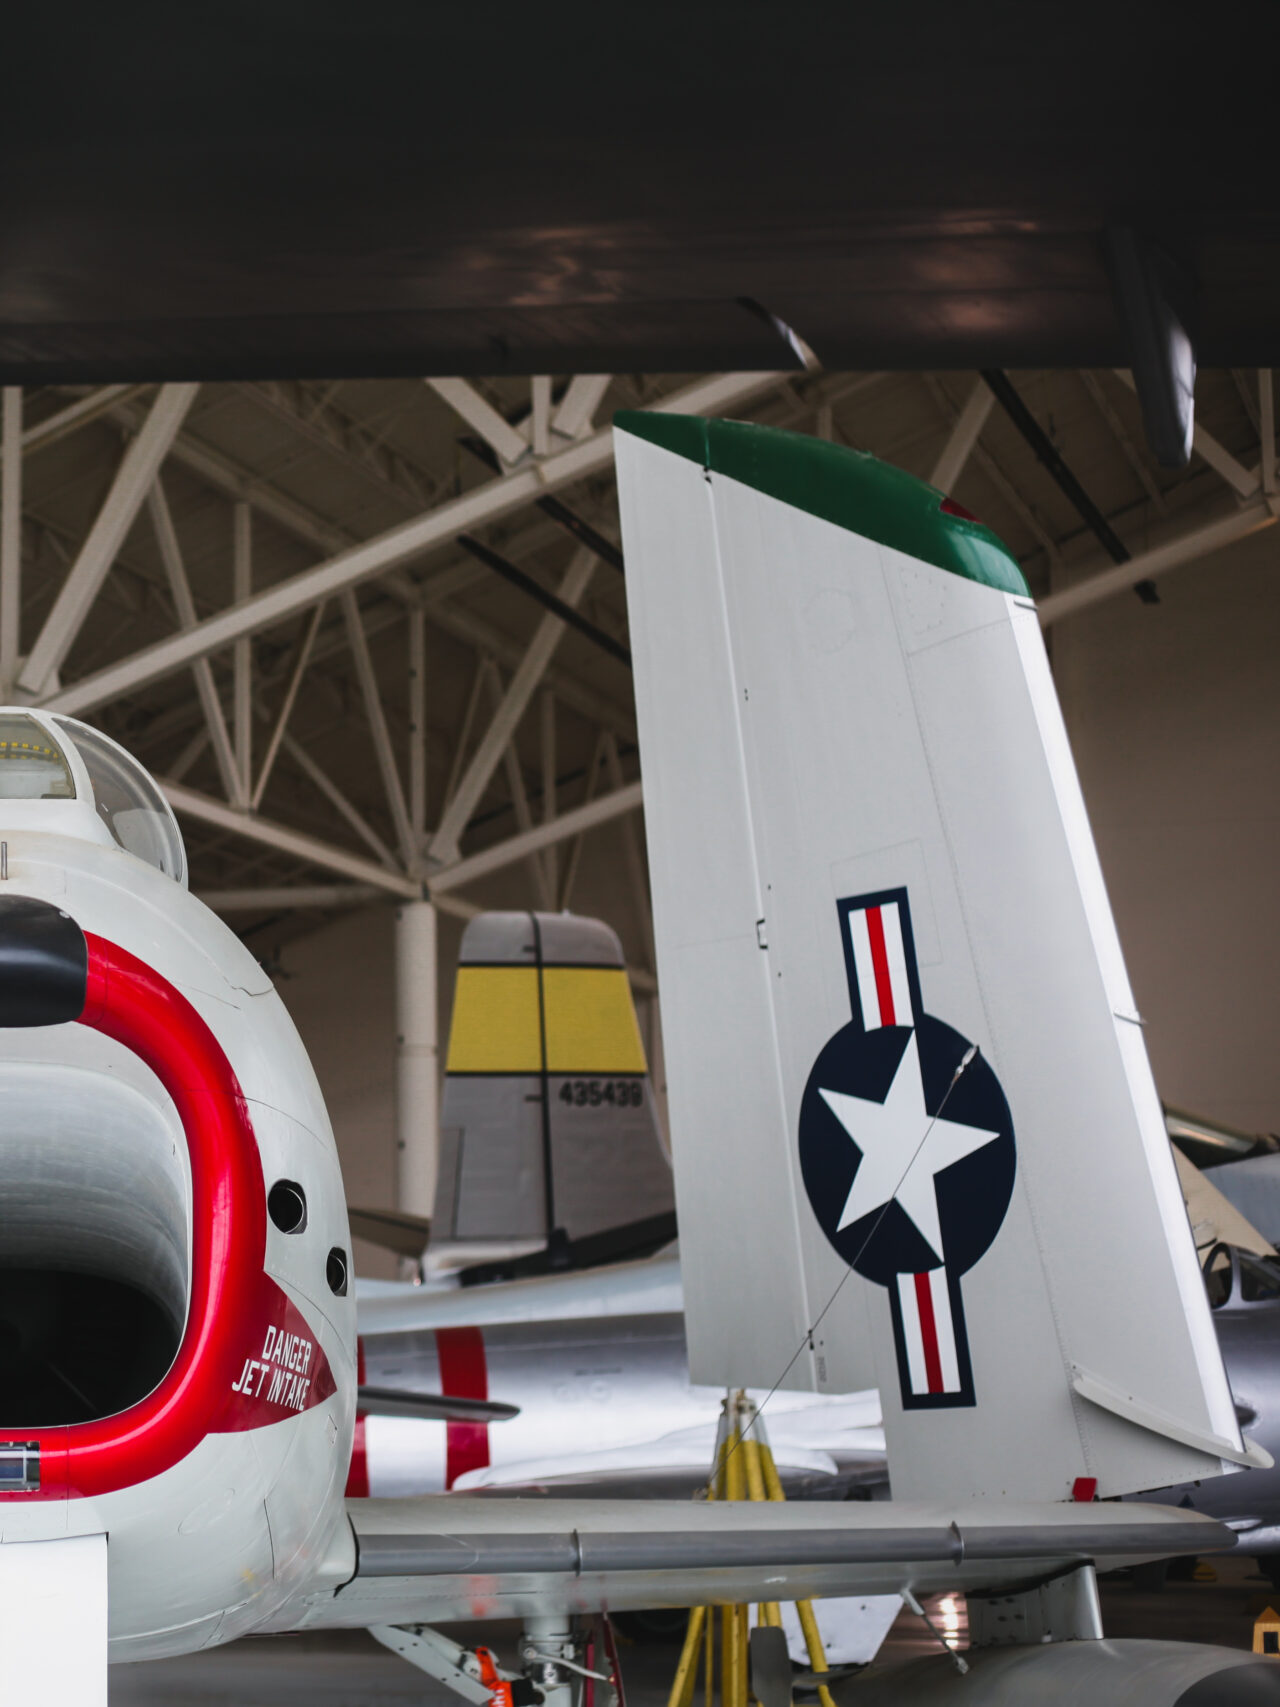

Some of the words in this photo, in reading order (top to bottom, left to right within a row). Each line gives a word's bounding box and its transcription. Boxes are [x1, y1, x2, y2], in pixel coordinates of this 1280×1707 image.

[261, 1324, 312, 1375] DANGER
[231, 1358, 270, 1398] JET
[266, 1368, 311, 1411] INTAKE
